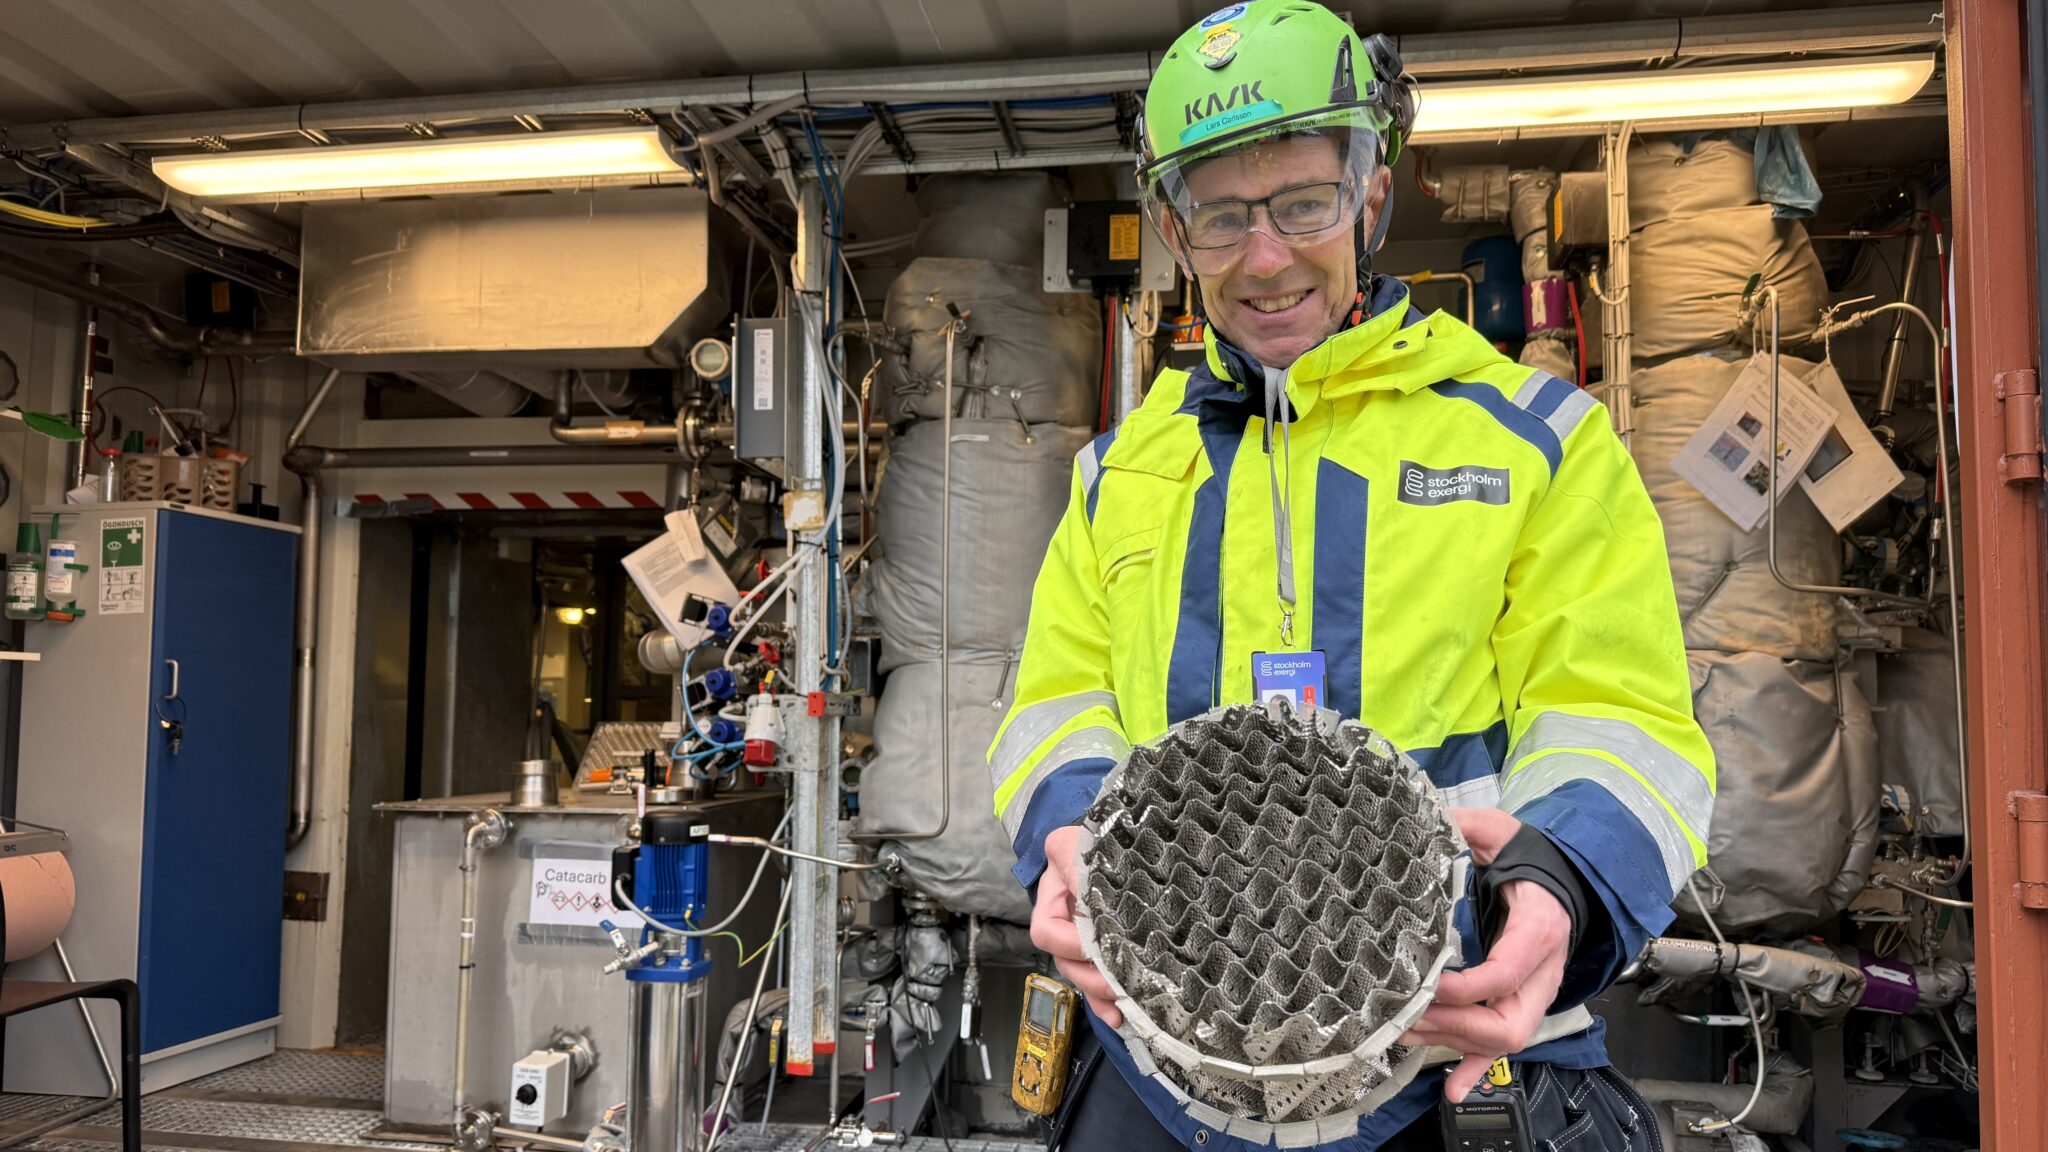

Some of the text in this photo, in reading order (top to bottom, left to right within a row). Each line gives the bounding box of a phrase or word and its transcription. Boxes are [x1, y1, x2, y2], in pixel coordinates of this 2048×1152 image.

[1185, 80, 1264, 125] KASK
[1205, 111, 1252, 131] Lars Carlsson
[1428, 472, 1502, 487] stockholm
[1428, 482, 1472, 498] exergi
[545, 868, 607, 885] Catacarb
